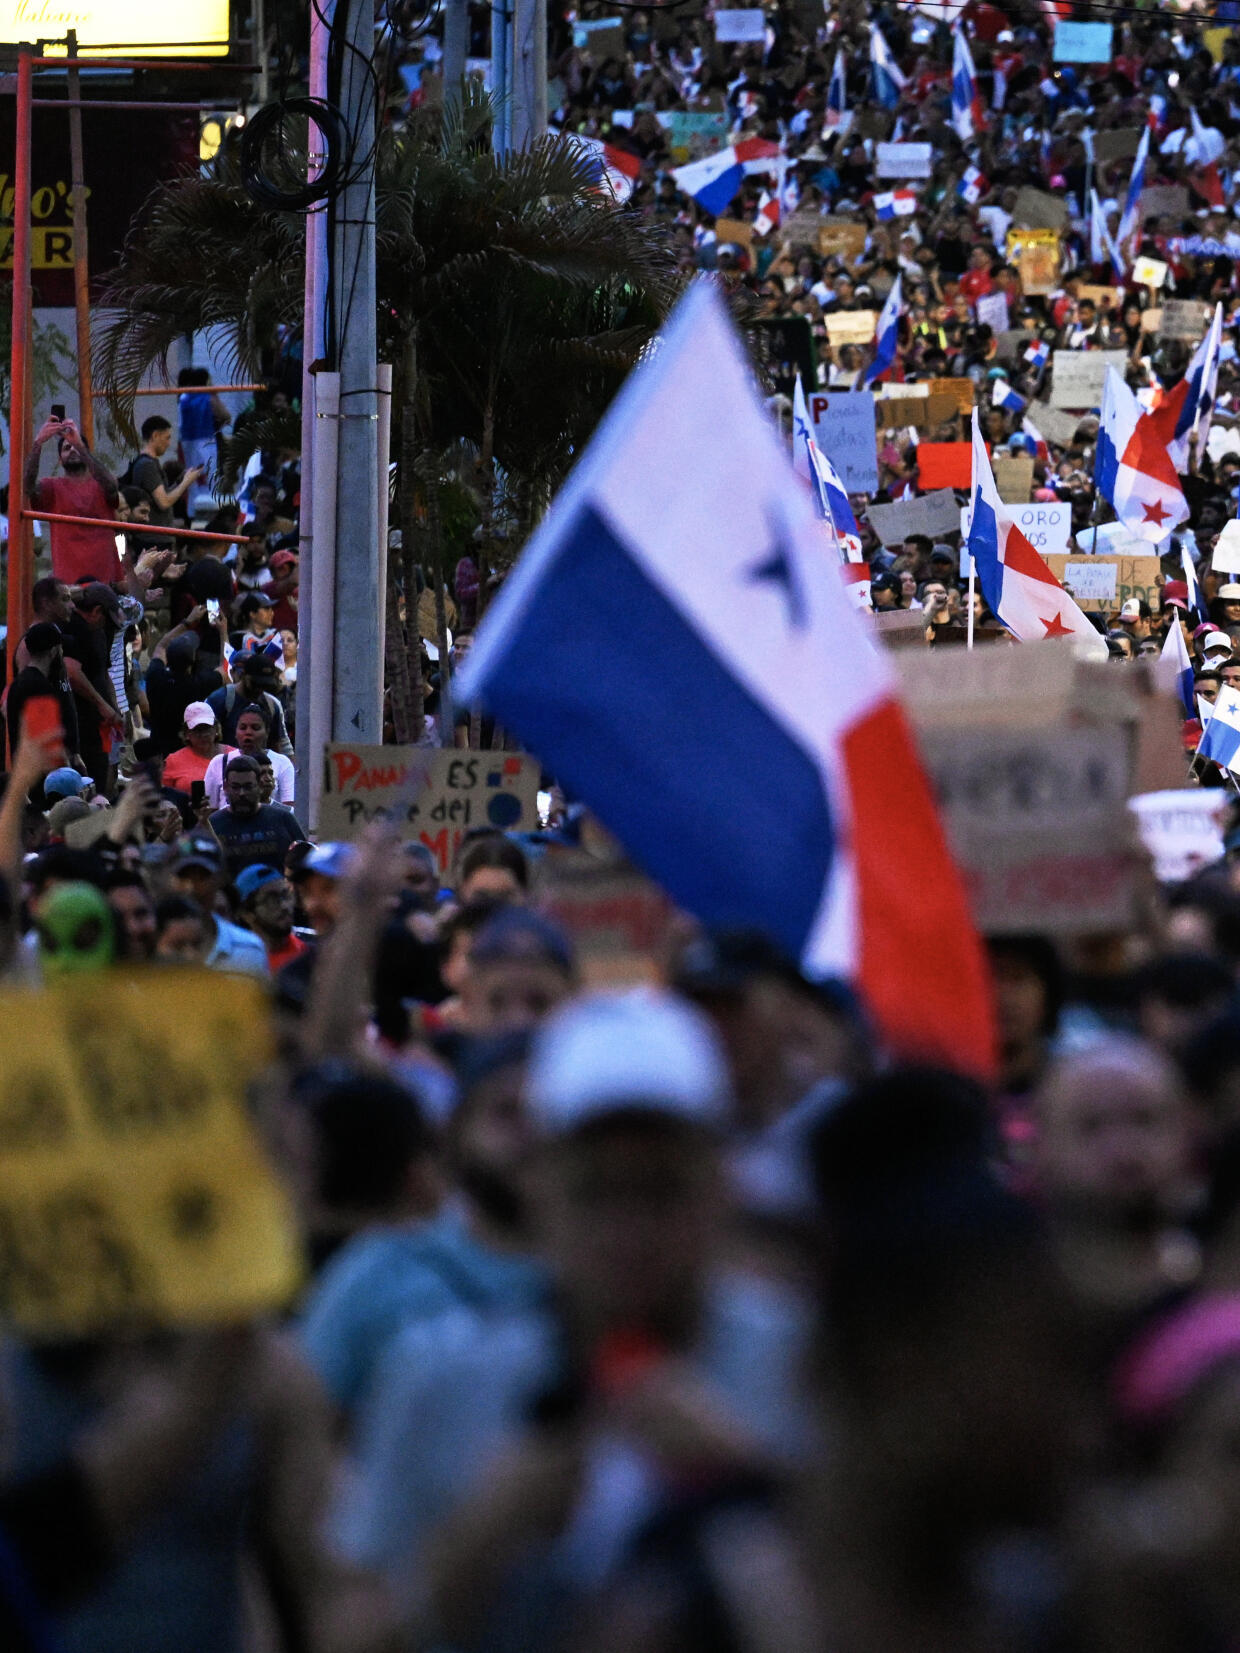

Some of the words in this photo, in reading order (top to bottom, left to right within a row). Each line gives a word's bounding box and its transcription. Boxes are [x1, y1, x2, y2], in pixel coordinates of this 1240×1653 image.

[1021, 510, 1061, 526] ORO
[447, 758, 479, 790] ES
[430, 798, 471, 824] del
